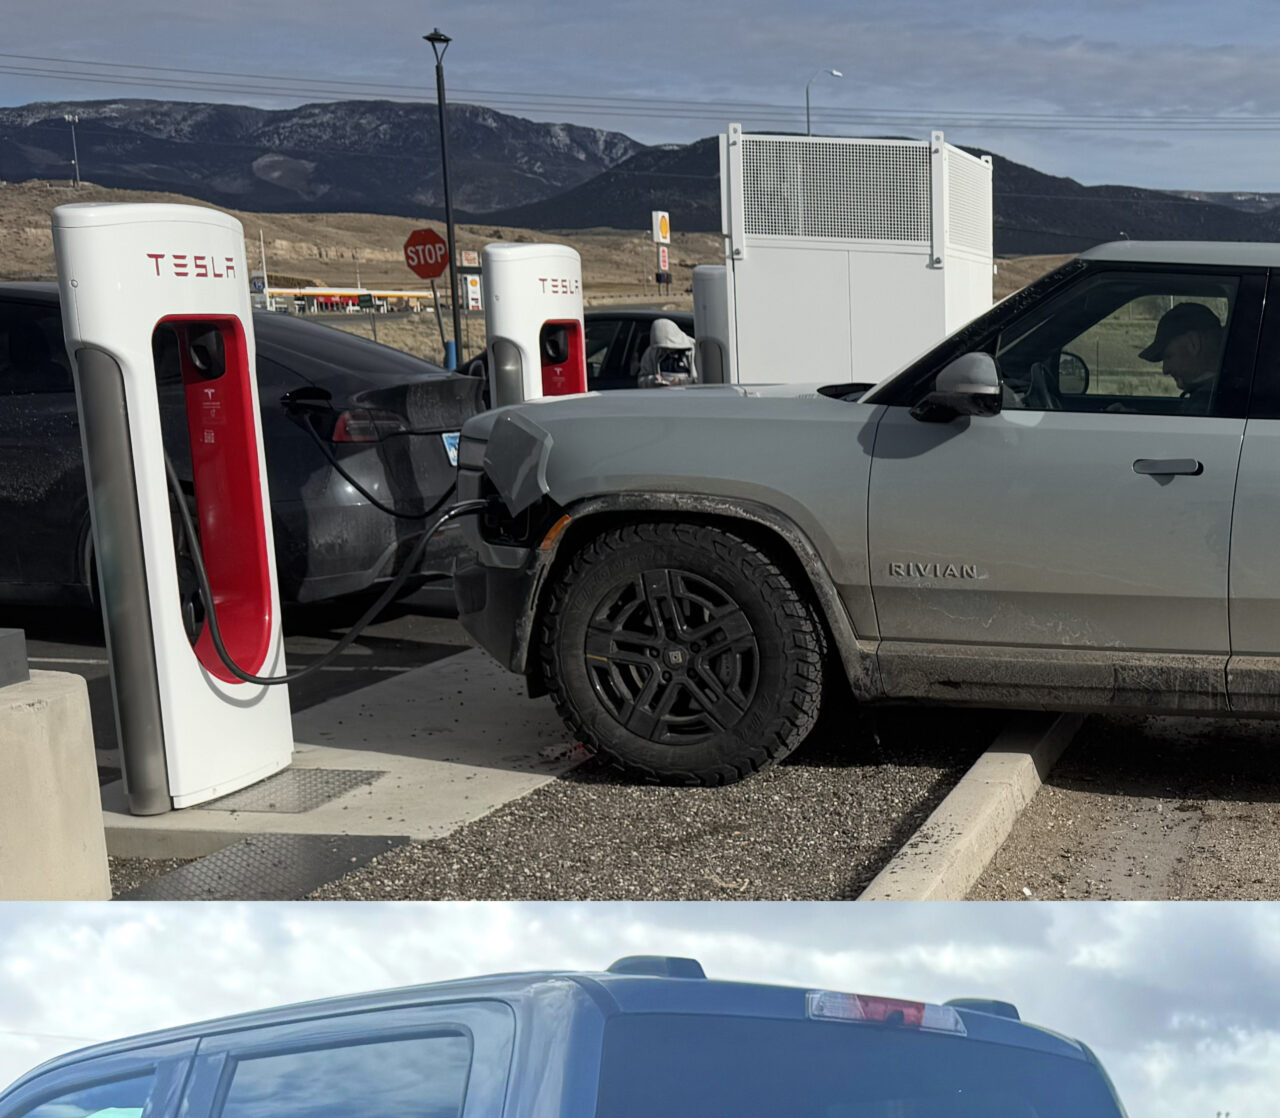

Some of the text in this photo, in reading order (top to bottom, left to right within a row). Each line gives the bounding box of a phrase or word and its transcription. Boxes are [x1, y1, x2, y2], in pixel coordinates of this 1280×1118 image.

[406, 243, 446, 266] STOP
[146, 253, 236, 279] TESLA
[538, 278, 580, 295] TESLA
[888, 561, 979, 580] RIVIAN
